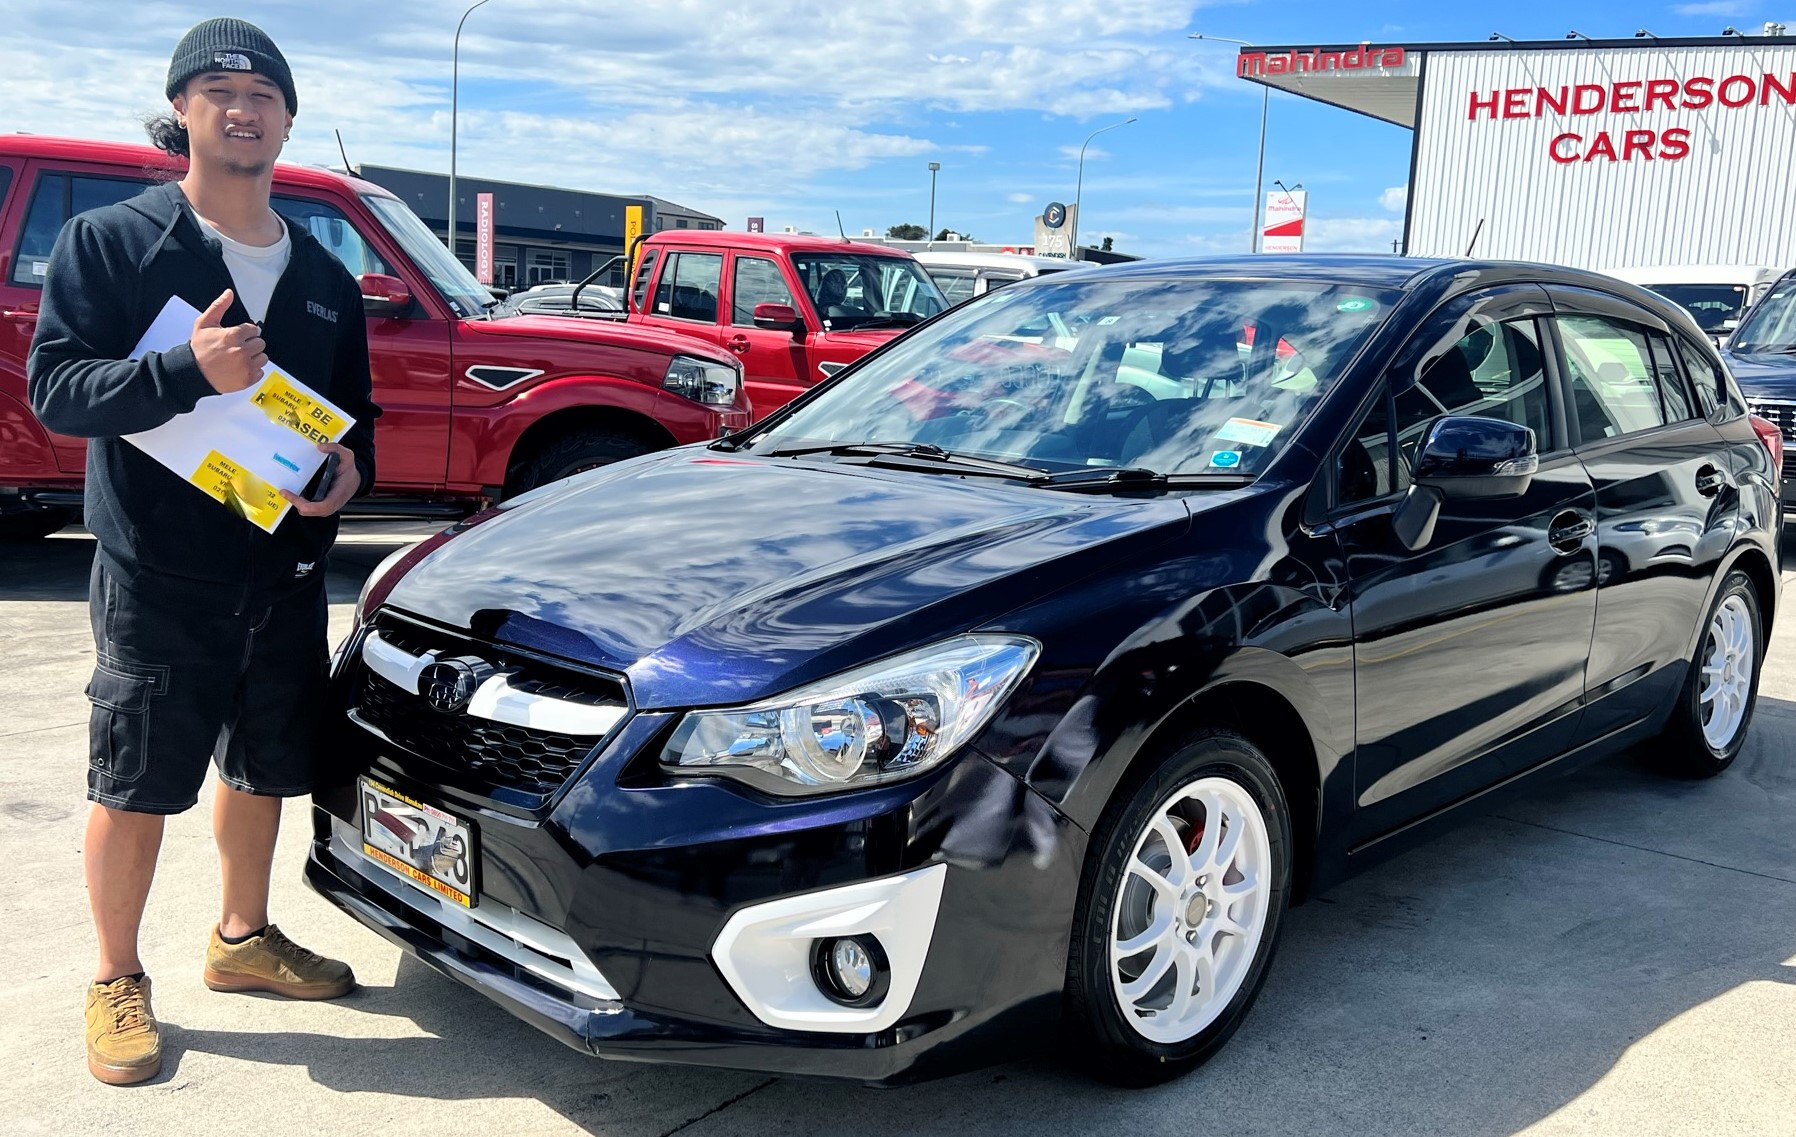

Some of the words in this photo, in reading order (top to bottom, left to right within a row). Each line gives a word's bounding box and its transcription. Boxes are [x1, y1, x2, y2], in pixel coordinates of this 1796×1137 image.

[1468, 72, 1796, 120] HENDERSON
[1549, 127, 1692, 164] CARS
[481, 201, 489, 278] RADIOLOGY
[1042, 233, 1063, 248] 175
[272, 392, 298, 410] SUBARU
[310, 407, 333, 426] BE
[206, 462, 233, 481] SUBARU
[219, 461, 237, 475] MELE
[369, 847, 410, 875] HENDERSON
[412, 870, 432, 886] CARS
[434, 881, 463, 903] LIMITED
